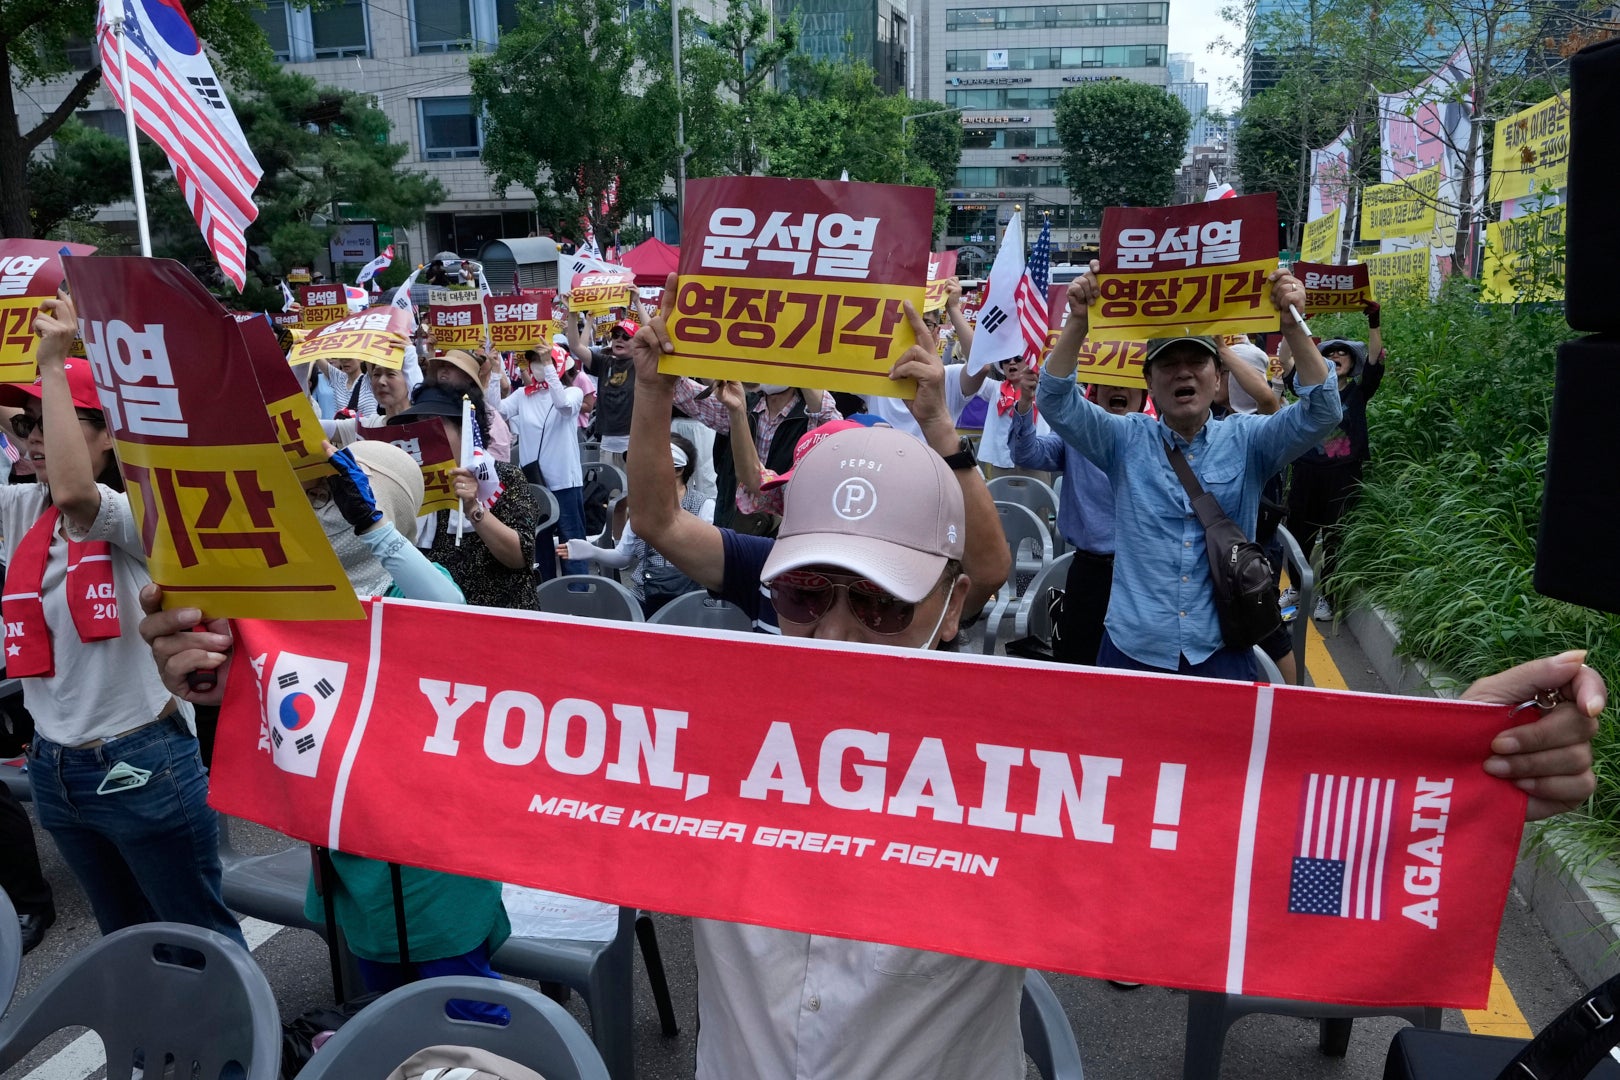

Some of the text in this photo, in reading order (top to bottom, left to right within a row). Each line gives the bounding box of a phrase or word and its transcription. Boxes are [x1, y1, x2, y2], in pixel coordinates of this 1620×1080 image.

[701, 207, 881, 279] 윤석열
[1116, 219, 1243, 269] 윤석열
[1305, 271, 1354, 290] 윤석열
[307, 290, 337, 306] 윤석열
[450, 290, 478, 302] 대통령님
[572, 285, 626, 304] 영장기각
[1100, 269, 1270, 318] 영장기각
[305, 307, 345, 322] 영장기각
[437, 311, 472, 327] 윤석열
[494, 302, 538, 322] 윤석열
[674, 281, 904, 361] 영장기각
[435, 328, 481, 343] 영장기각
[490, 324, 548, 343] 영장기각
[840, 458, 883, 472] PEPSI
[85, 583, 116, 600] AG
[93, 603, 119, 620] 20
[418, 677, 710, 802] YOON,
[739, 720, 1124, 844] AGAIN
[528, 794, 1000, 878] MAKE KOREA GREAT AGAIN
[1401, 776, 1454, 930] AGAIN
